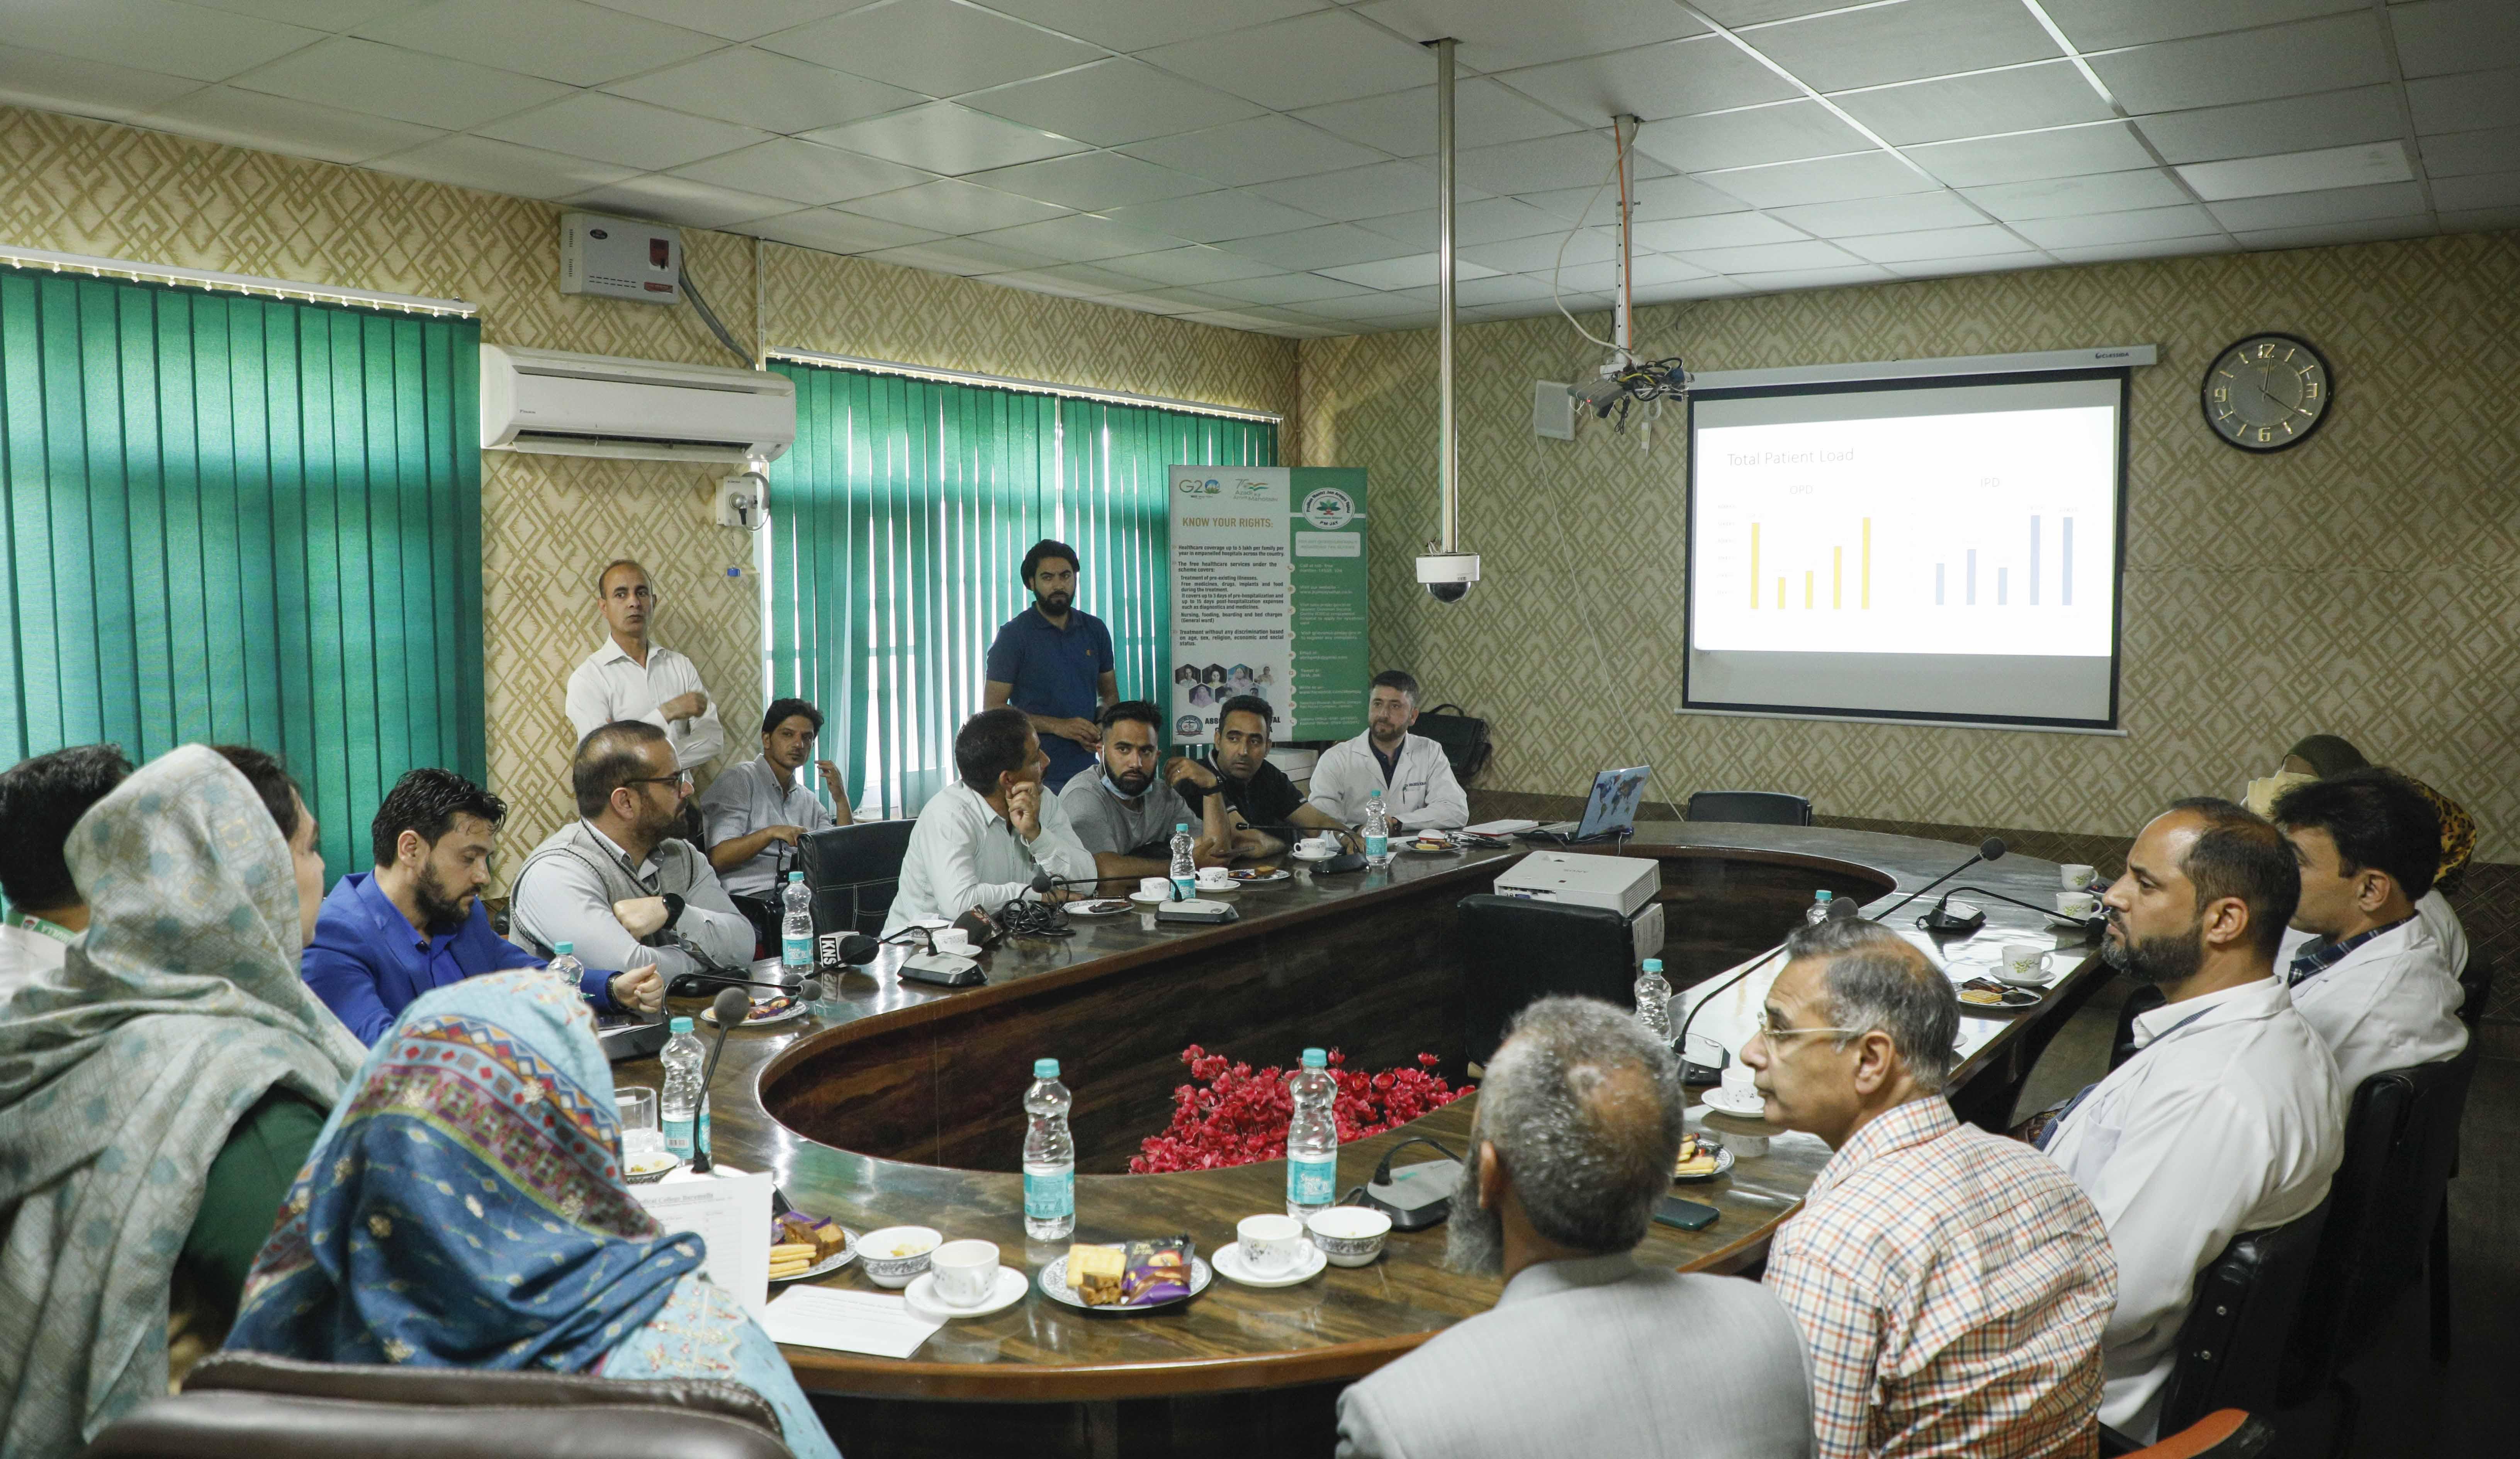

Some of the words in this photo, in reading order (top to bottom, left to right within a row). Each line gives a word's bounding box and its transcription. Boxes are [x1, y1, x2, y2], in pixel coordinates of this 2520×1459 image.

[2214, 388, 2227, 403] 9
[2306, 383, 2318, 398] 3
[2259, 427, 2270, 442] 6
[1727, 451, 1760, 466] Total
[1766, 451, 1814, 465] Patient
[1820, 447, 1854, 463] Load
[1790, 485, 1813, 495] OPD
[1183, 518, 1209, 527] KNOW
[1213, 518, 1236, 527] YOUR
[1240, 518, 1274, 527] RIGHTS:
[821, 940, 837, 965] KNS
